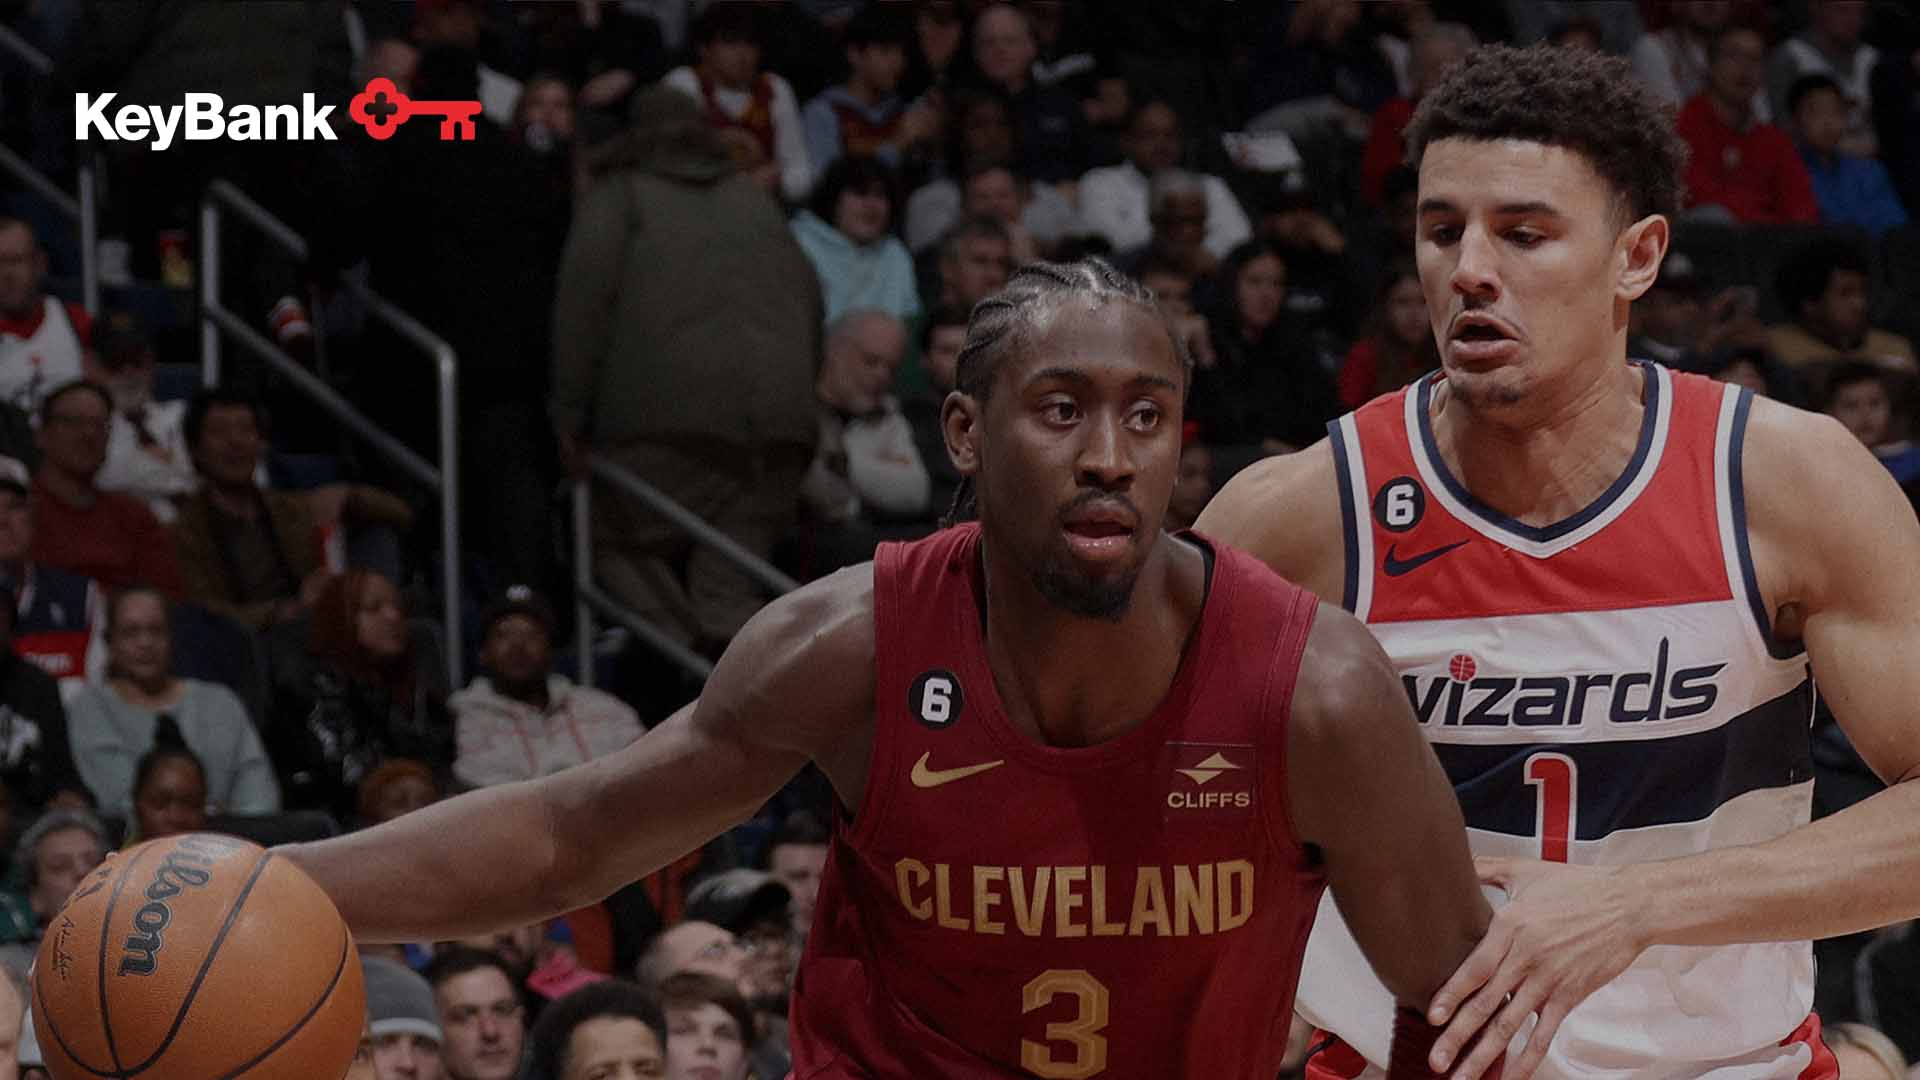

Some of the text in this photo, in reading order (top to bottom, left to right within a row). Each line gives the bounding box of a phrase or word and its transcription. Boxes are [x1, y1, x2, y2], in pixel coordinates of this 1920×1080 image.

[1386, 483, 1415, 526] 6
[920, 676, 953, 724] 6
[1166, 791, 1250, 809] CLIFFS
[1523, 751, 1578, 864] 1
[895, 857, 1255, 938] CLEVELAND
[1019, 968, 1110, 1080] 3
